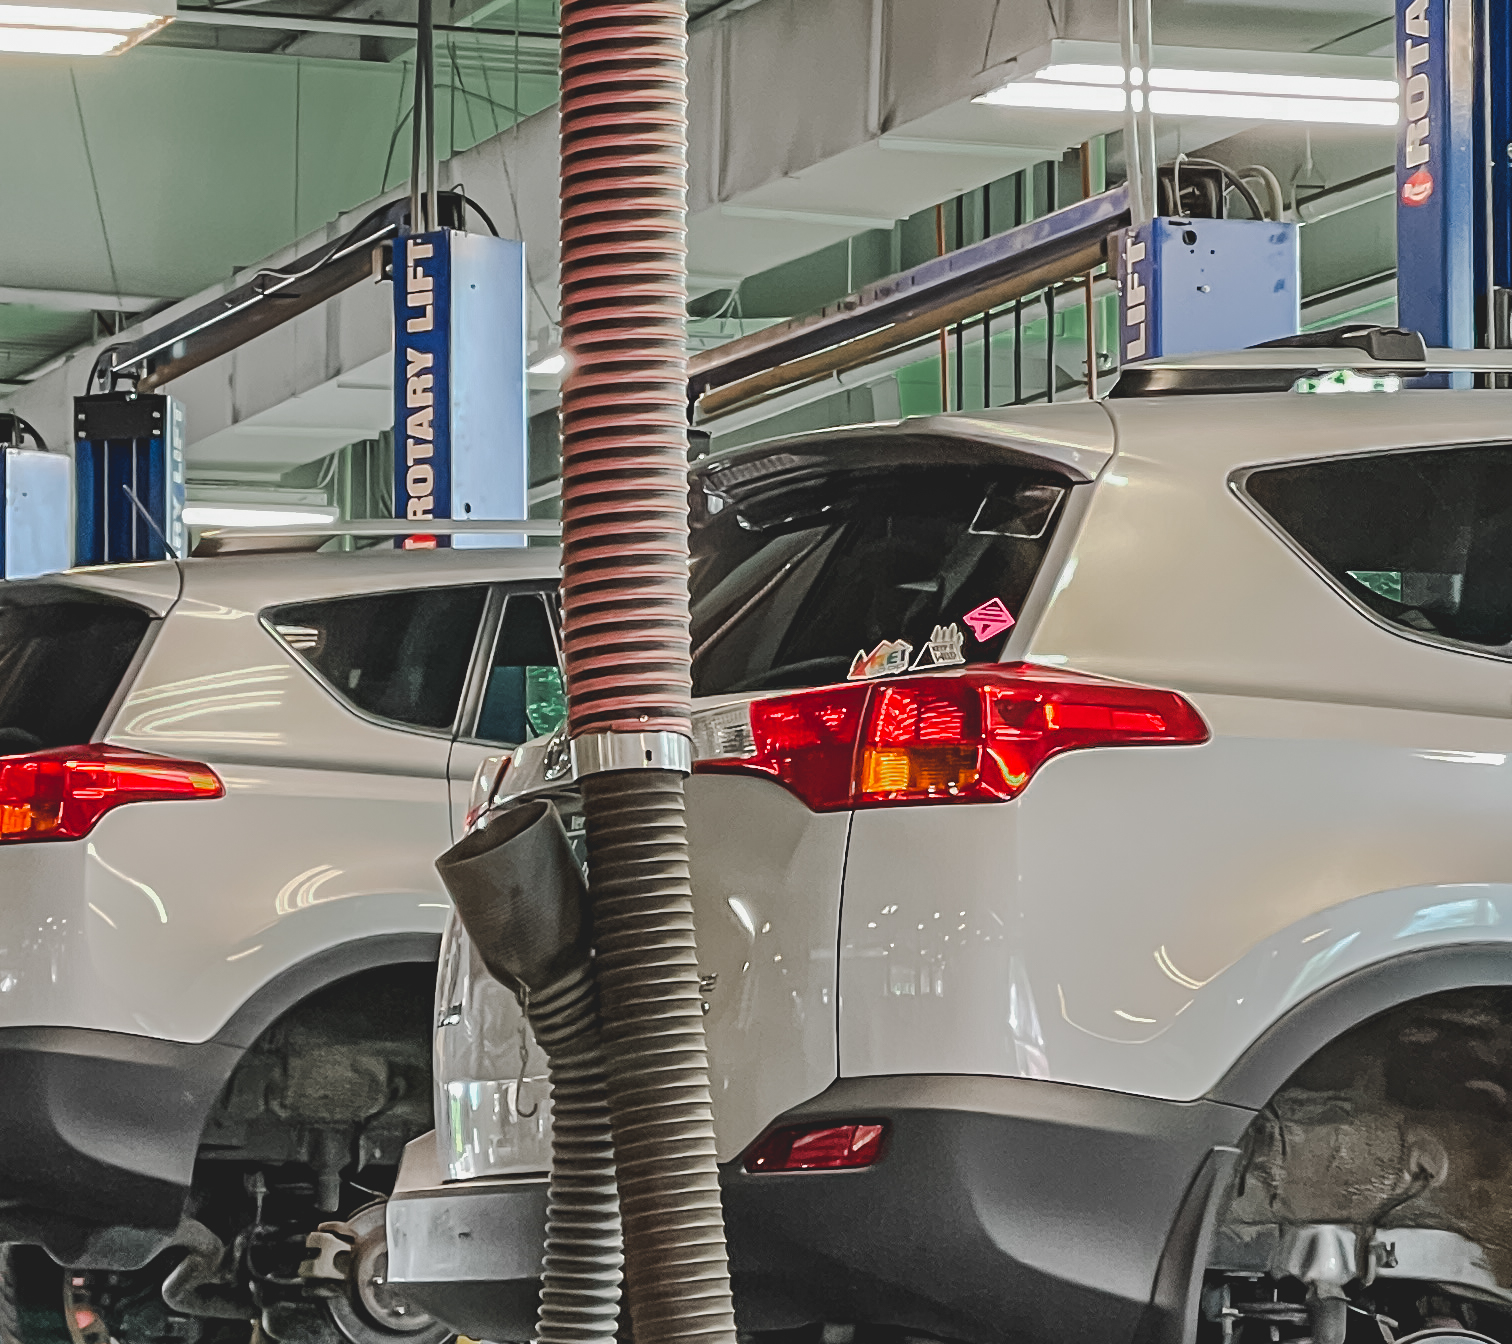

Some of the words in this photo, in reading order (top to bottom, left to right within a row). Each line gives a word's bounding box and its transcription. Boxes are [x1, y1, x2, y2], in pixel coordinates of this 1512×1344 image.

[406, 239, 435, 333] LIFT
[1126, 238, 1146, 360] LIFT
[406, 347, 435, 521] ROTARY
